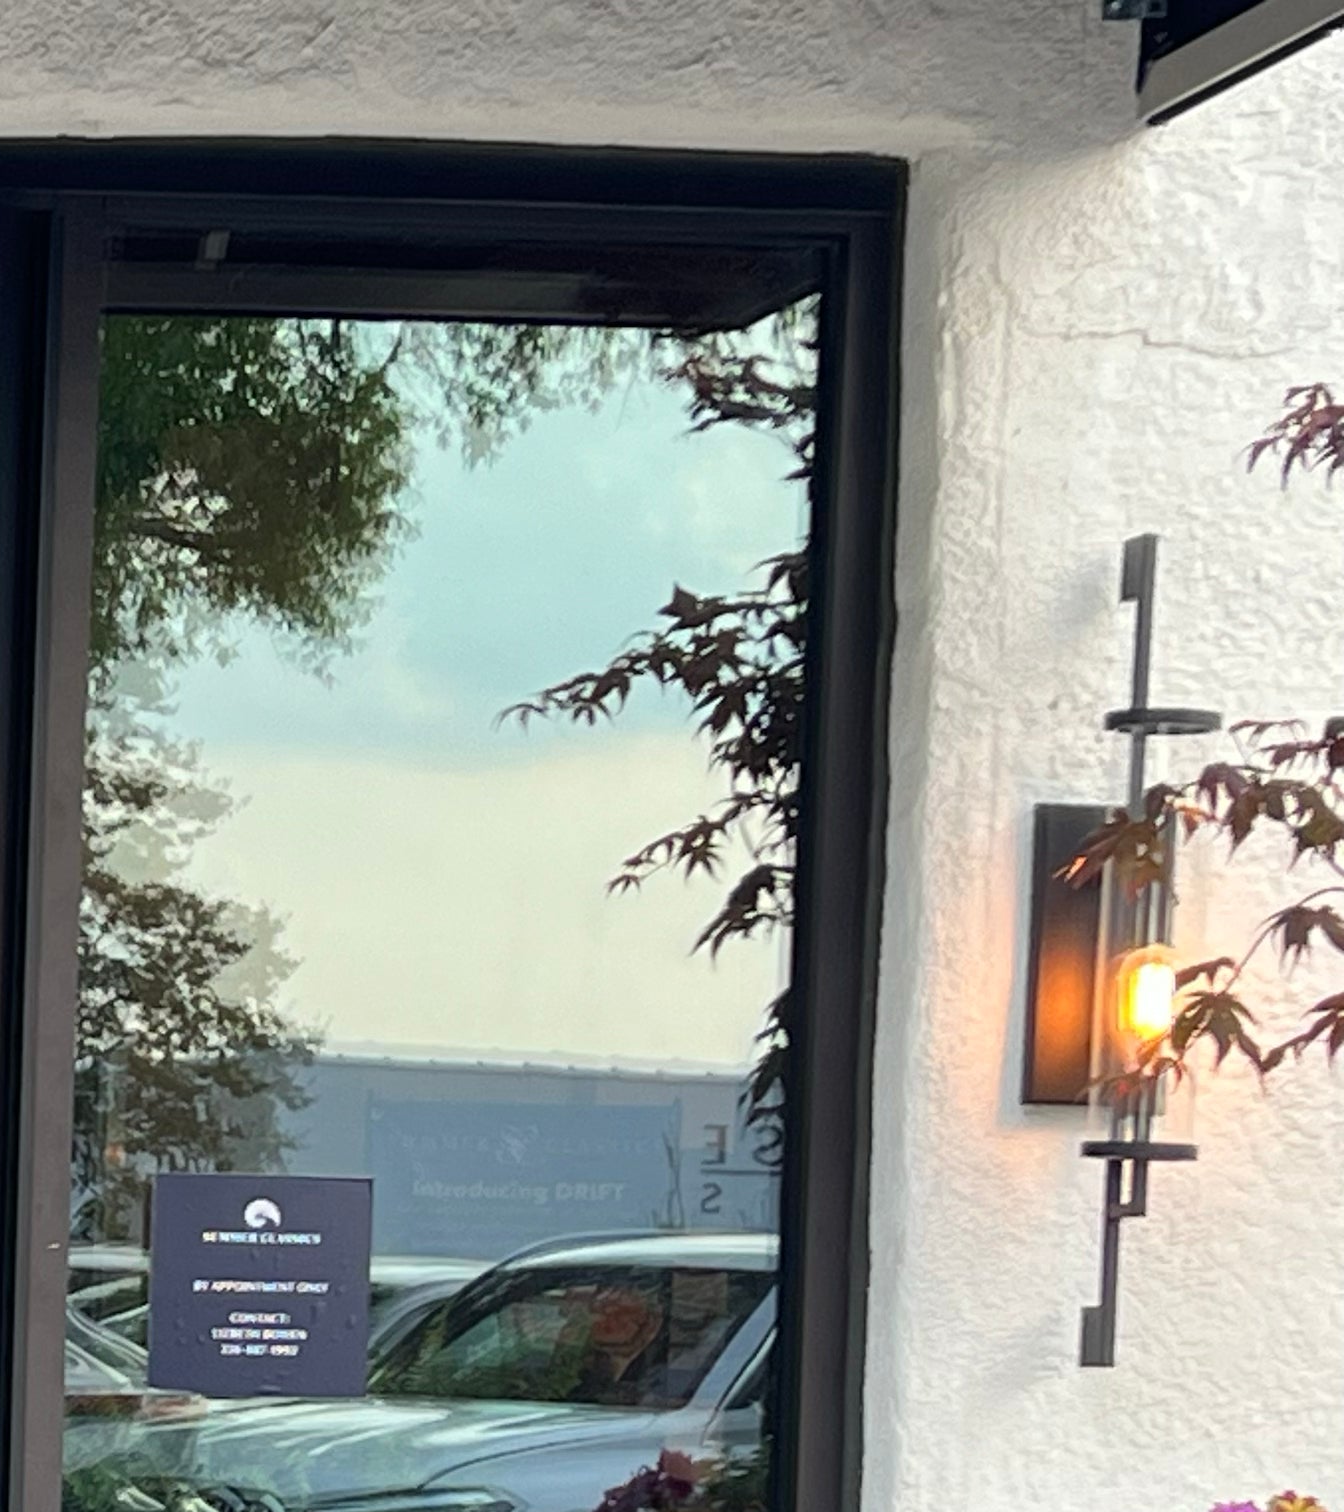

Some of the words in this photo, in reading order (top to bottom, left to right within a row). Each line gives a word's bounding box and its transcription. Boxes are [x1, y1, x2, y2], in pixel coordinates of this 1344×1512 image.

[412, 1178, 549, 1205] Introducing
[555, 1181, 628, 1202] DRIFT
[211, 1279, 296, 1293] APPOINTMENT
